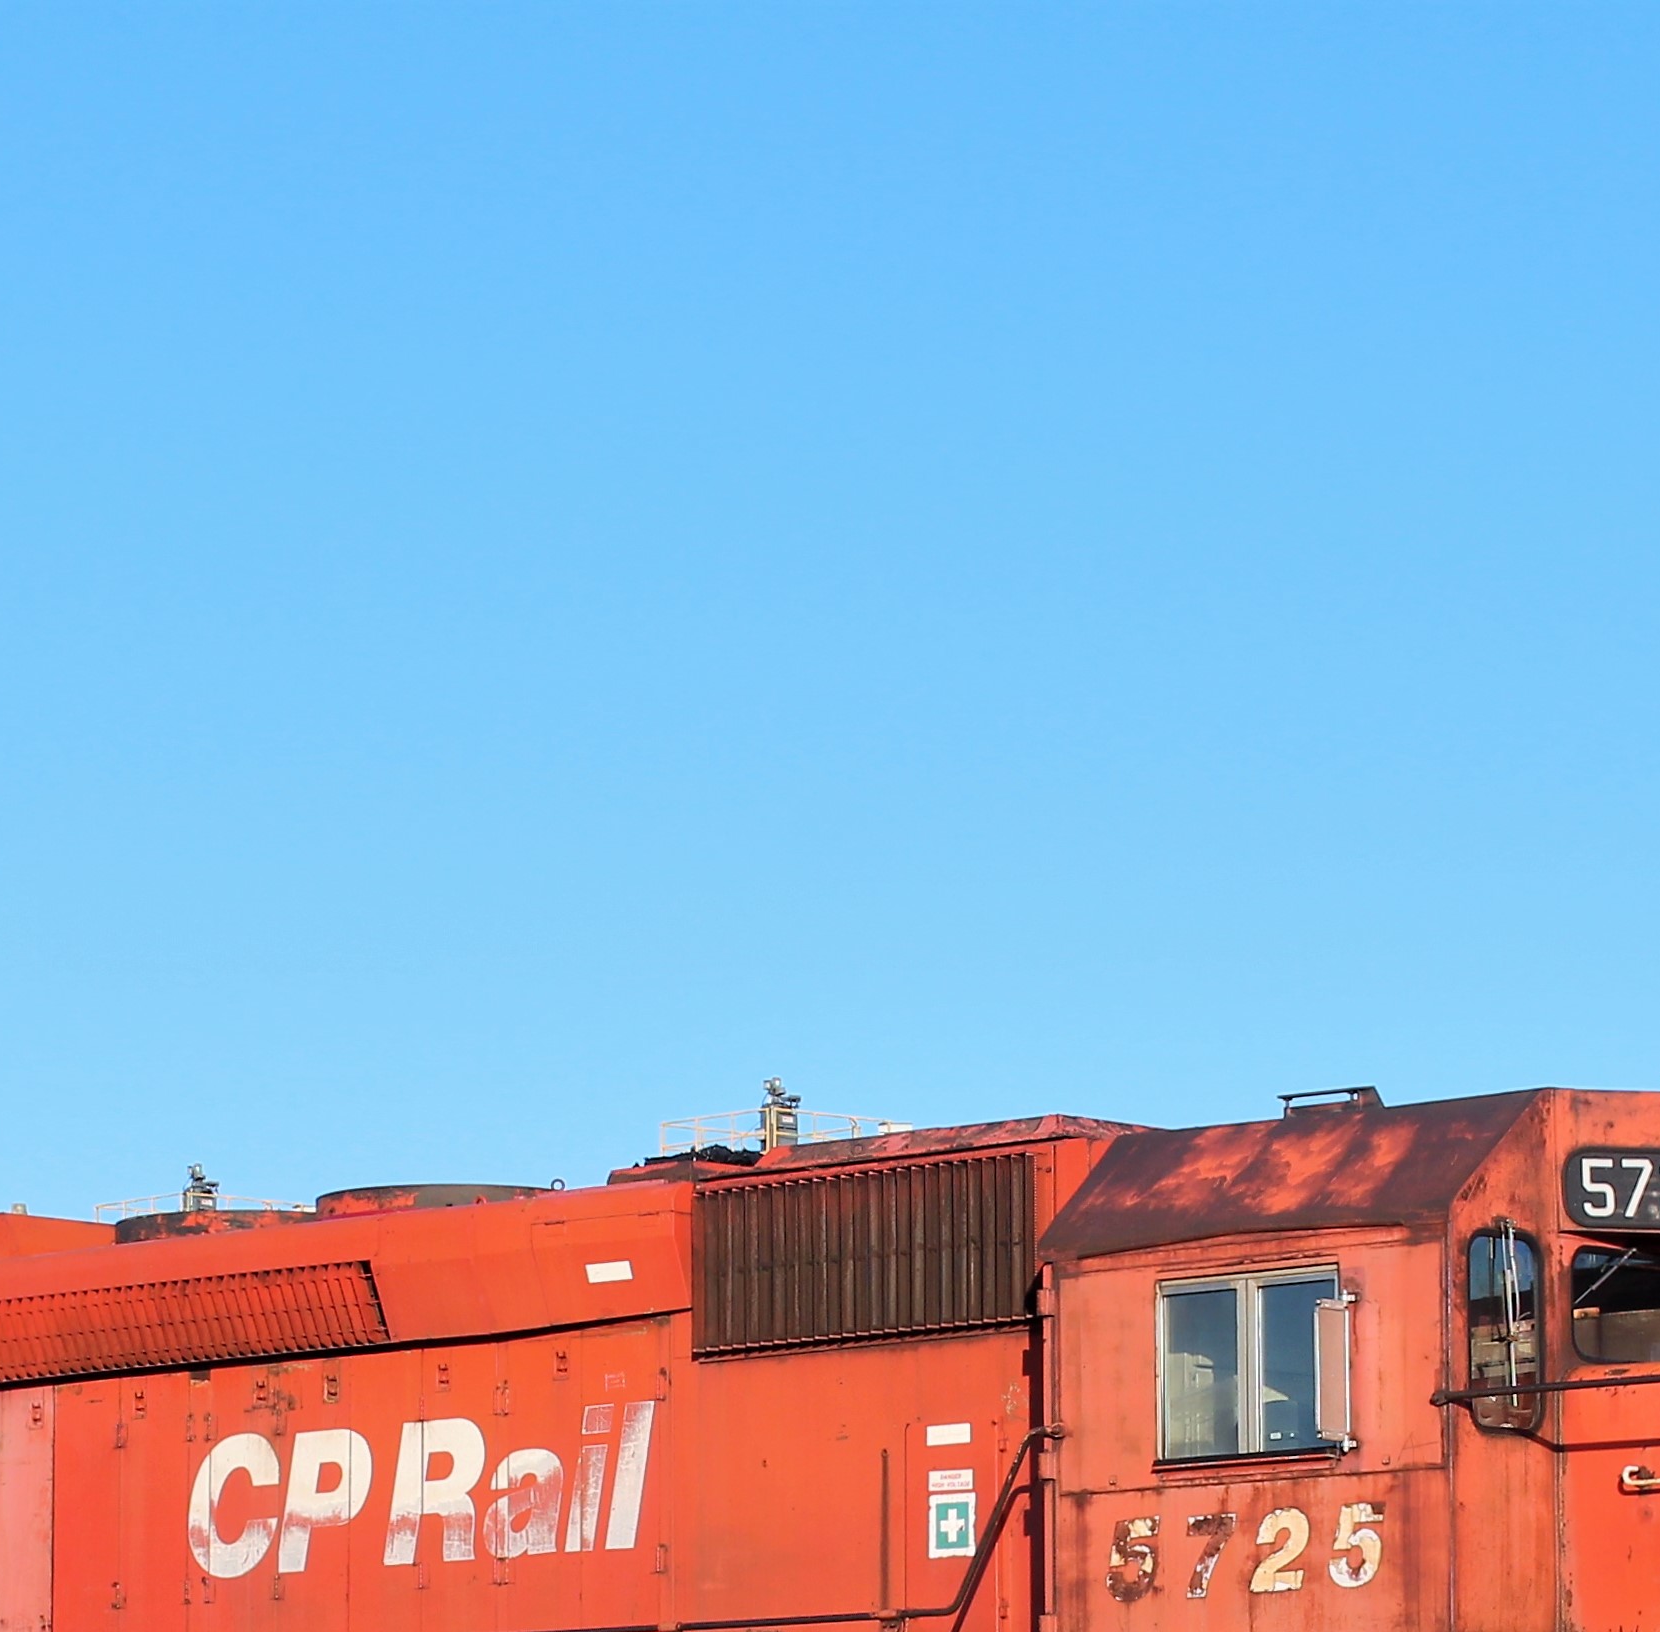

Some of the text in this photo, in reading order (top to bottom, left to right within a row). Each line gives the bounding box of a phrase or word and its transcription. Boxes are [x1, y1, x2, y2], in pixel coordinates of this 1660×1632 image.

[188, 1400, 655, 1579] CP Rail
[1106, 1502, 1386, 1602] 5725
